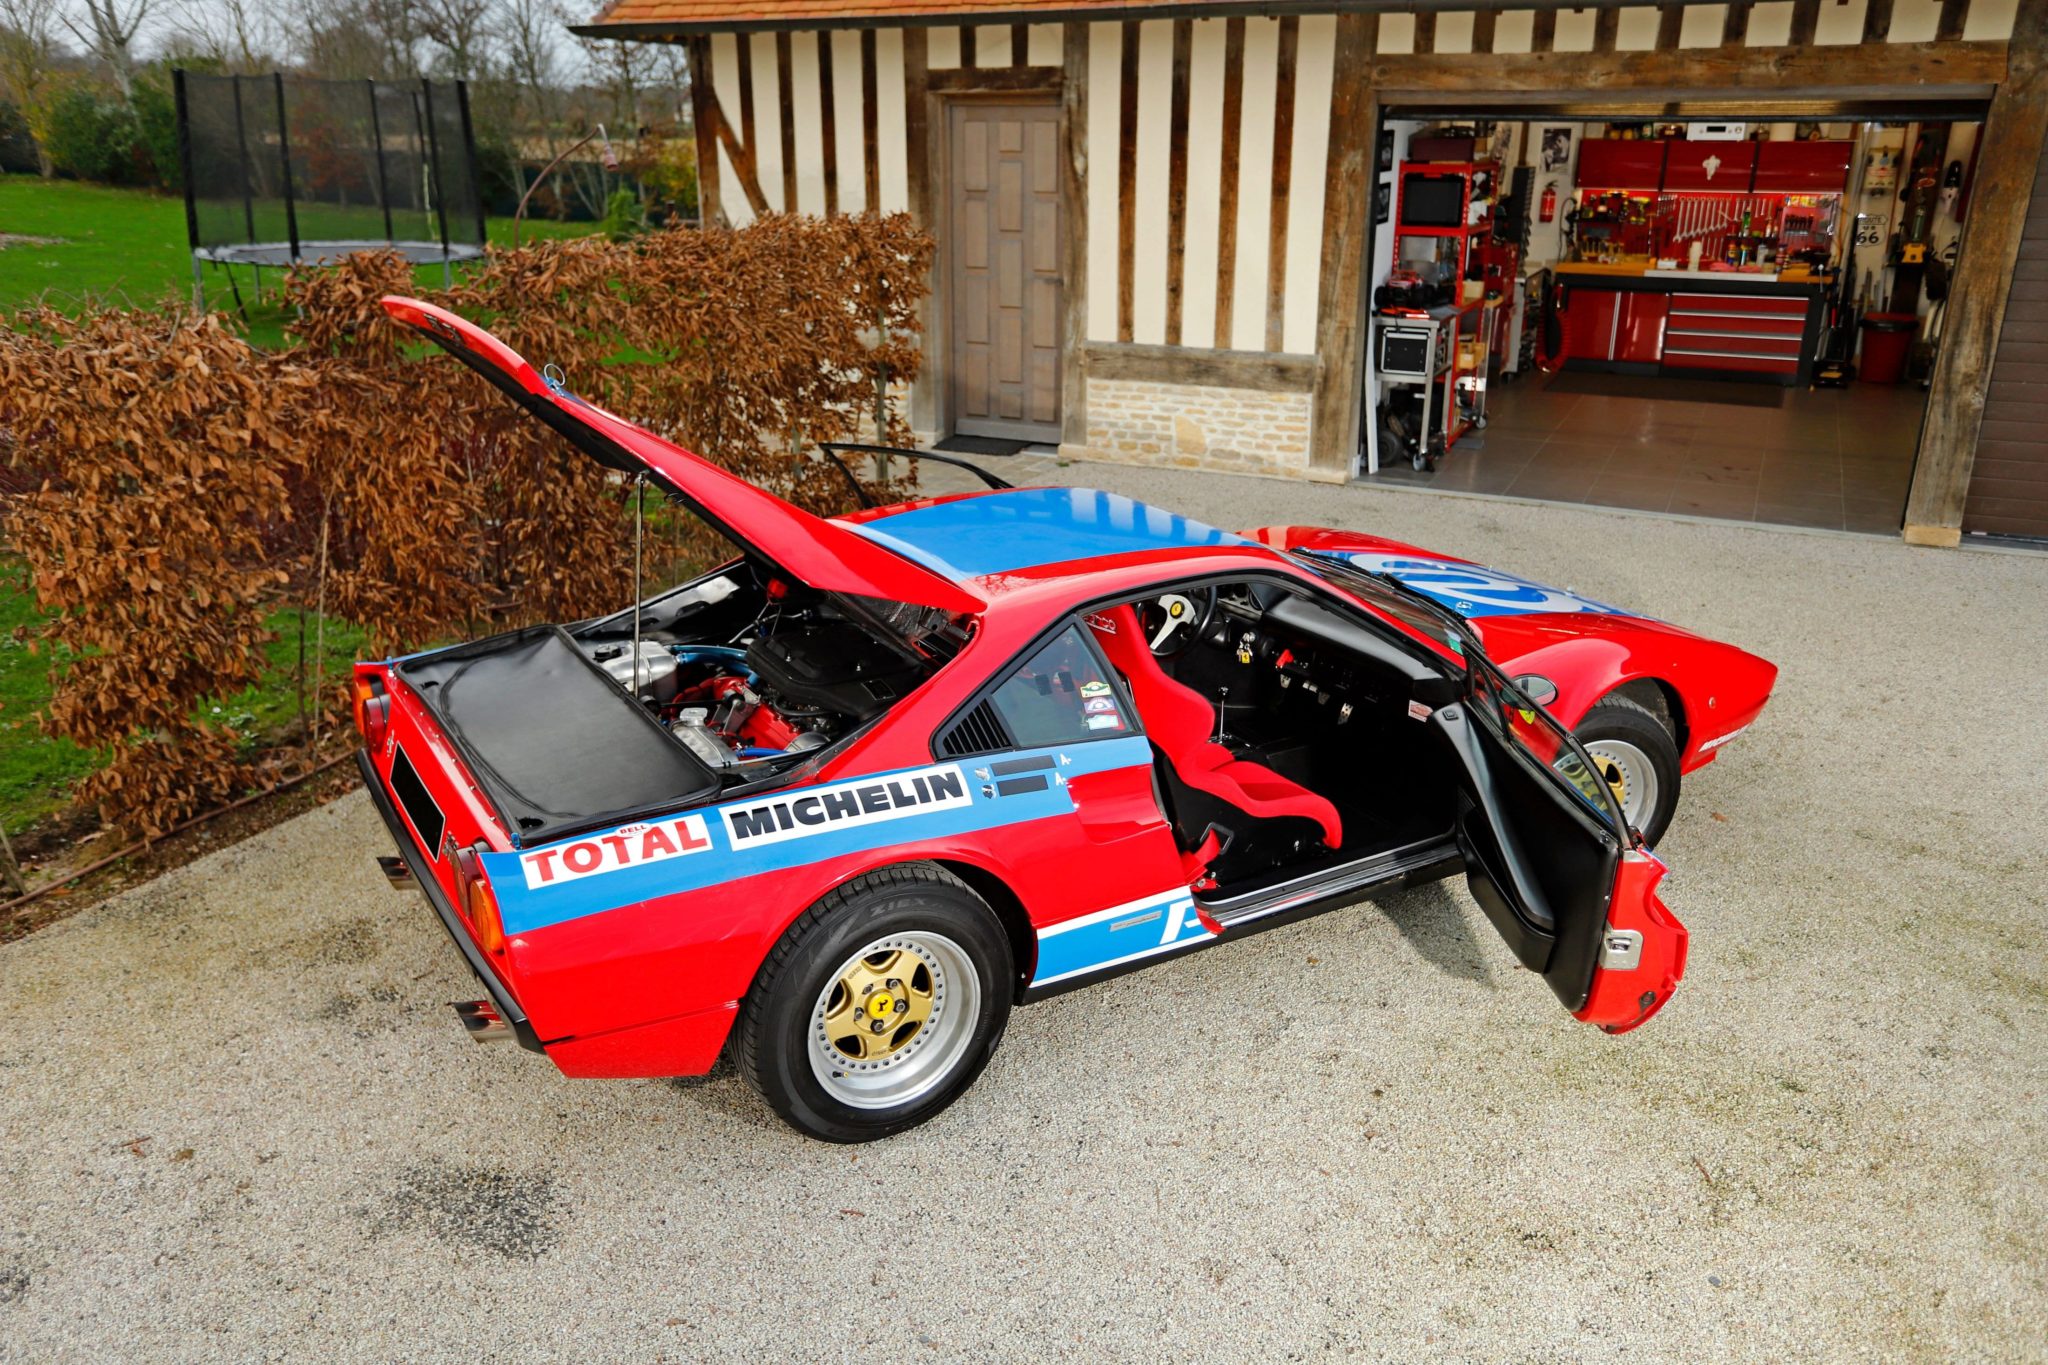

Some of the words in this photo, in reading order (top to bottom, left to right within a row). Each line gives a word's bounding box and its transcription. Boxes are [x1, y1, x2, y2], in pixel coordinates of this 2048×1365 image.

[1856, 231, 1879, 244] 66
[728, 771, 964, 840] MICHELIN
[619, 824, 647, 834] BELL
[524, 820, 709, 882] TOTAL
[870, 897, 928, 918] ZIEX
